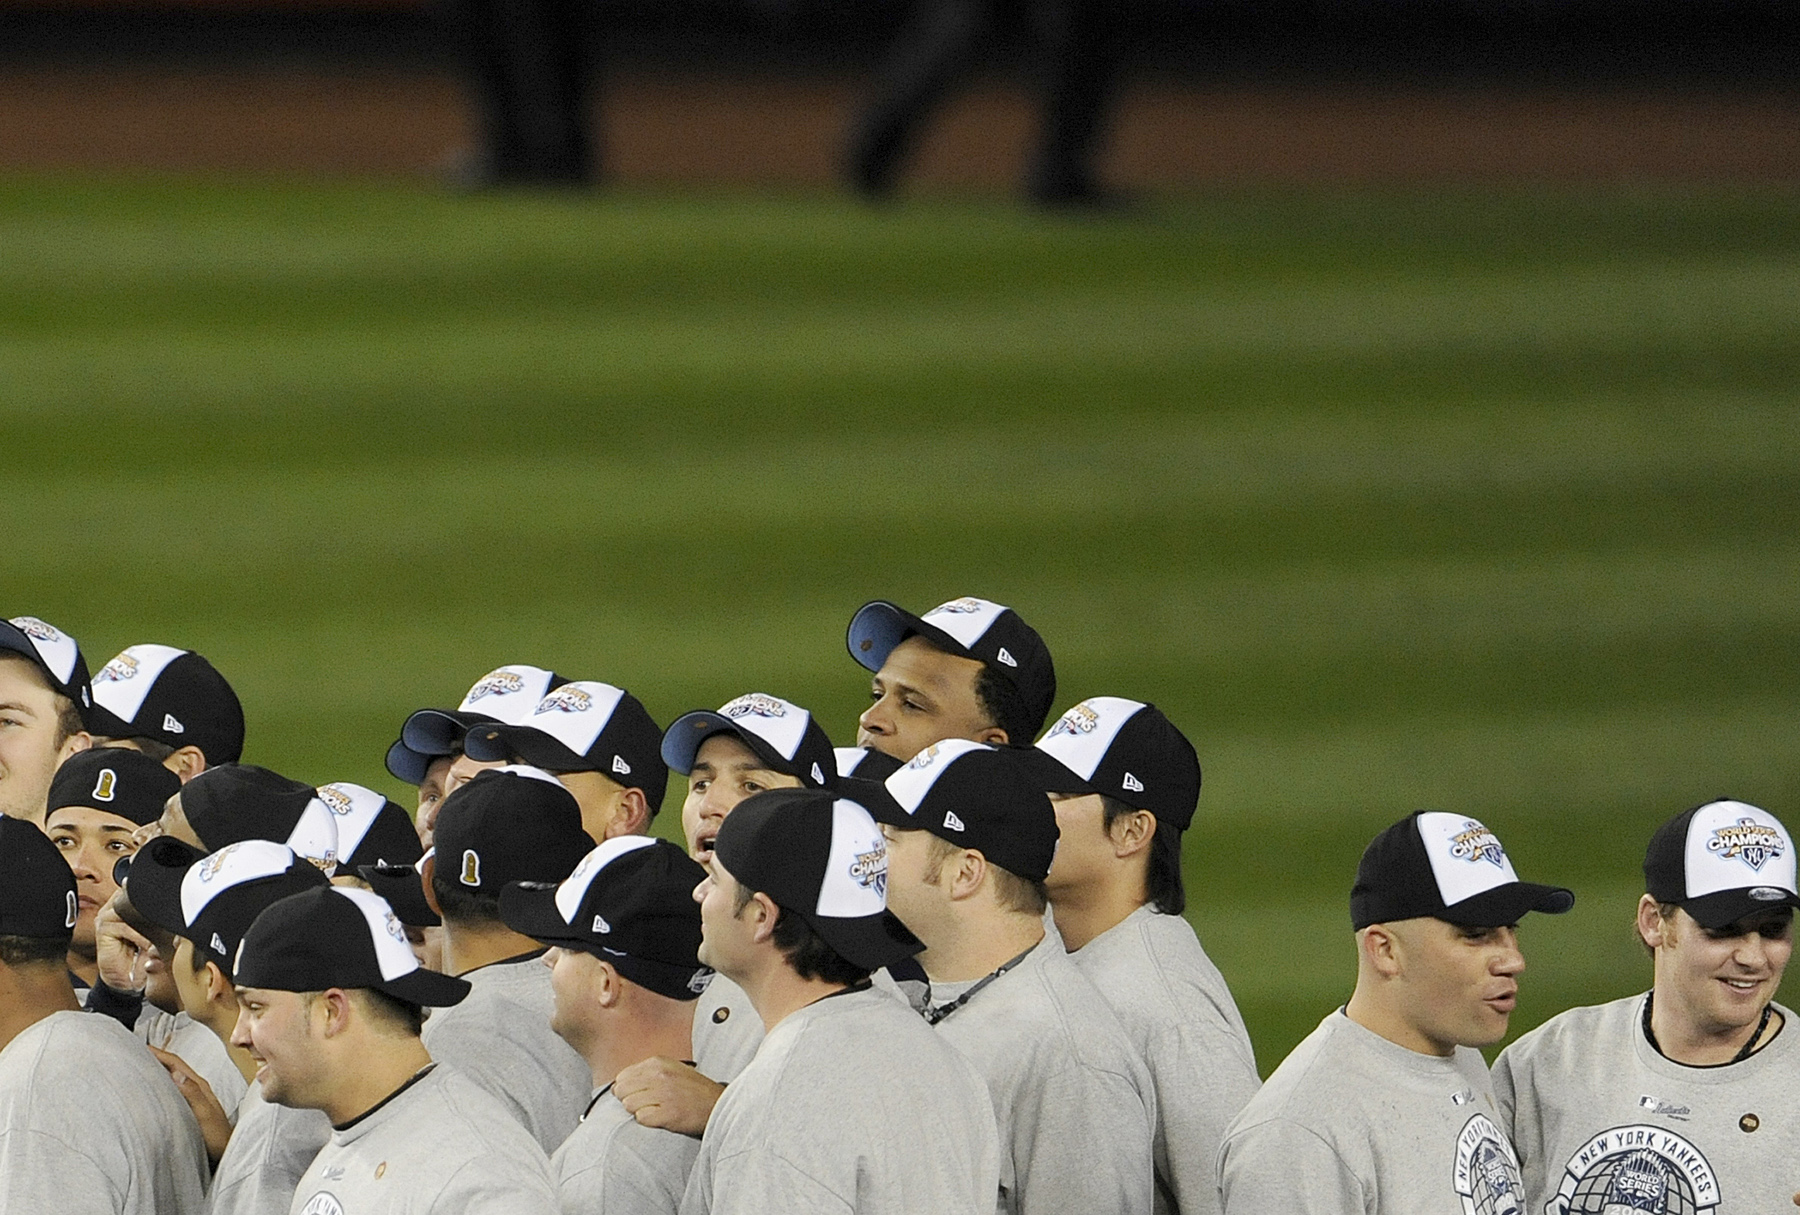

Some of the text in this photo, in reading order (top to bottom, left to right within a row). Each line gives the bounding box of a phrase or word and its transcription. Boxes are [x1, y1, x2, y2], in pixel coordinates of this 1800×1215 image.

[1707, 833, 1785, 851] CHAMPIONS
[1579, 1131, 1712, 1194] NEW YORK YANKEES
[1618, 1176, 1661, 1198] SERIES
[1625, 1169, 1660, 1185] WORLD
